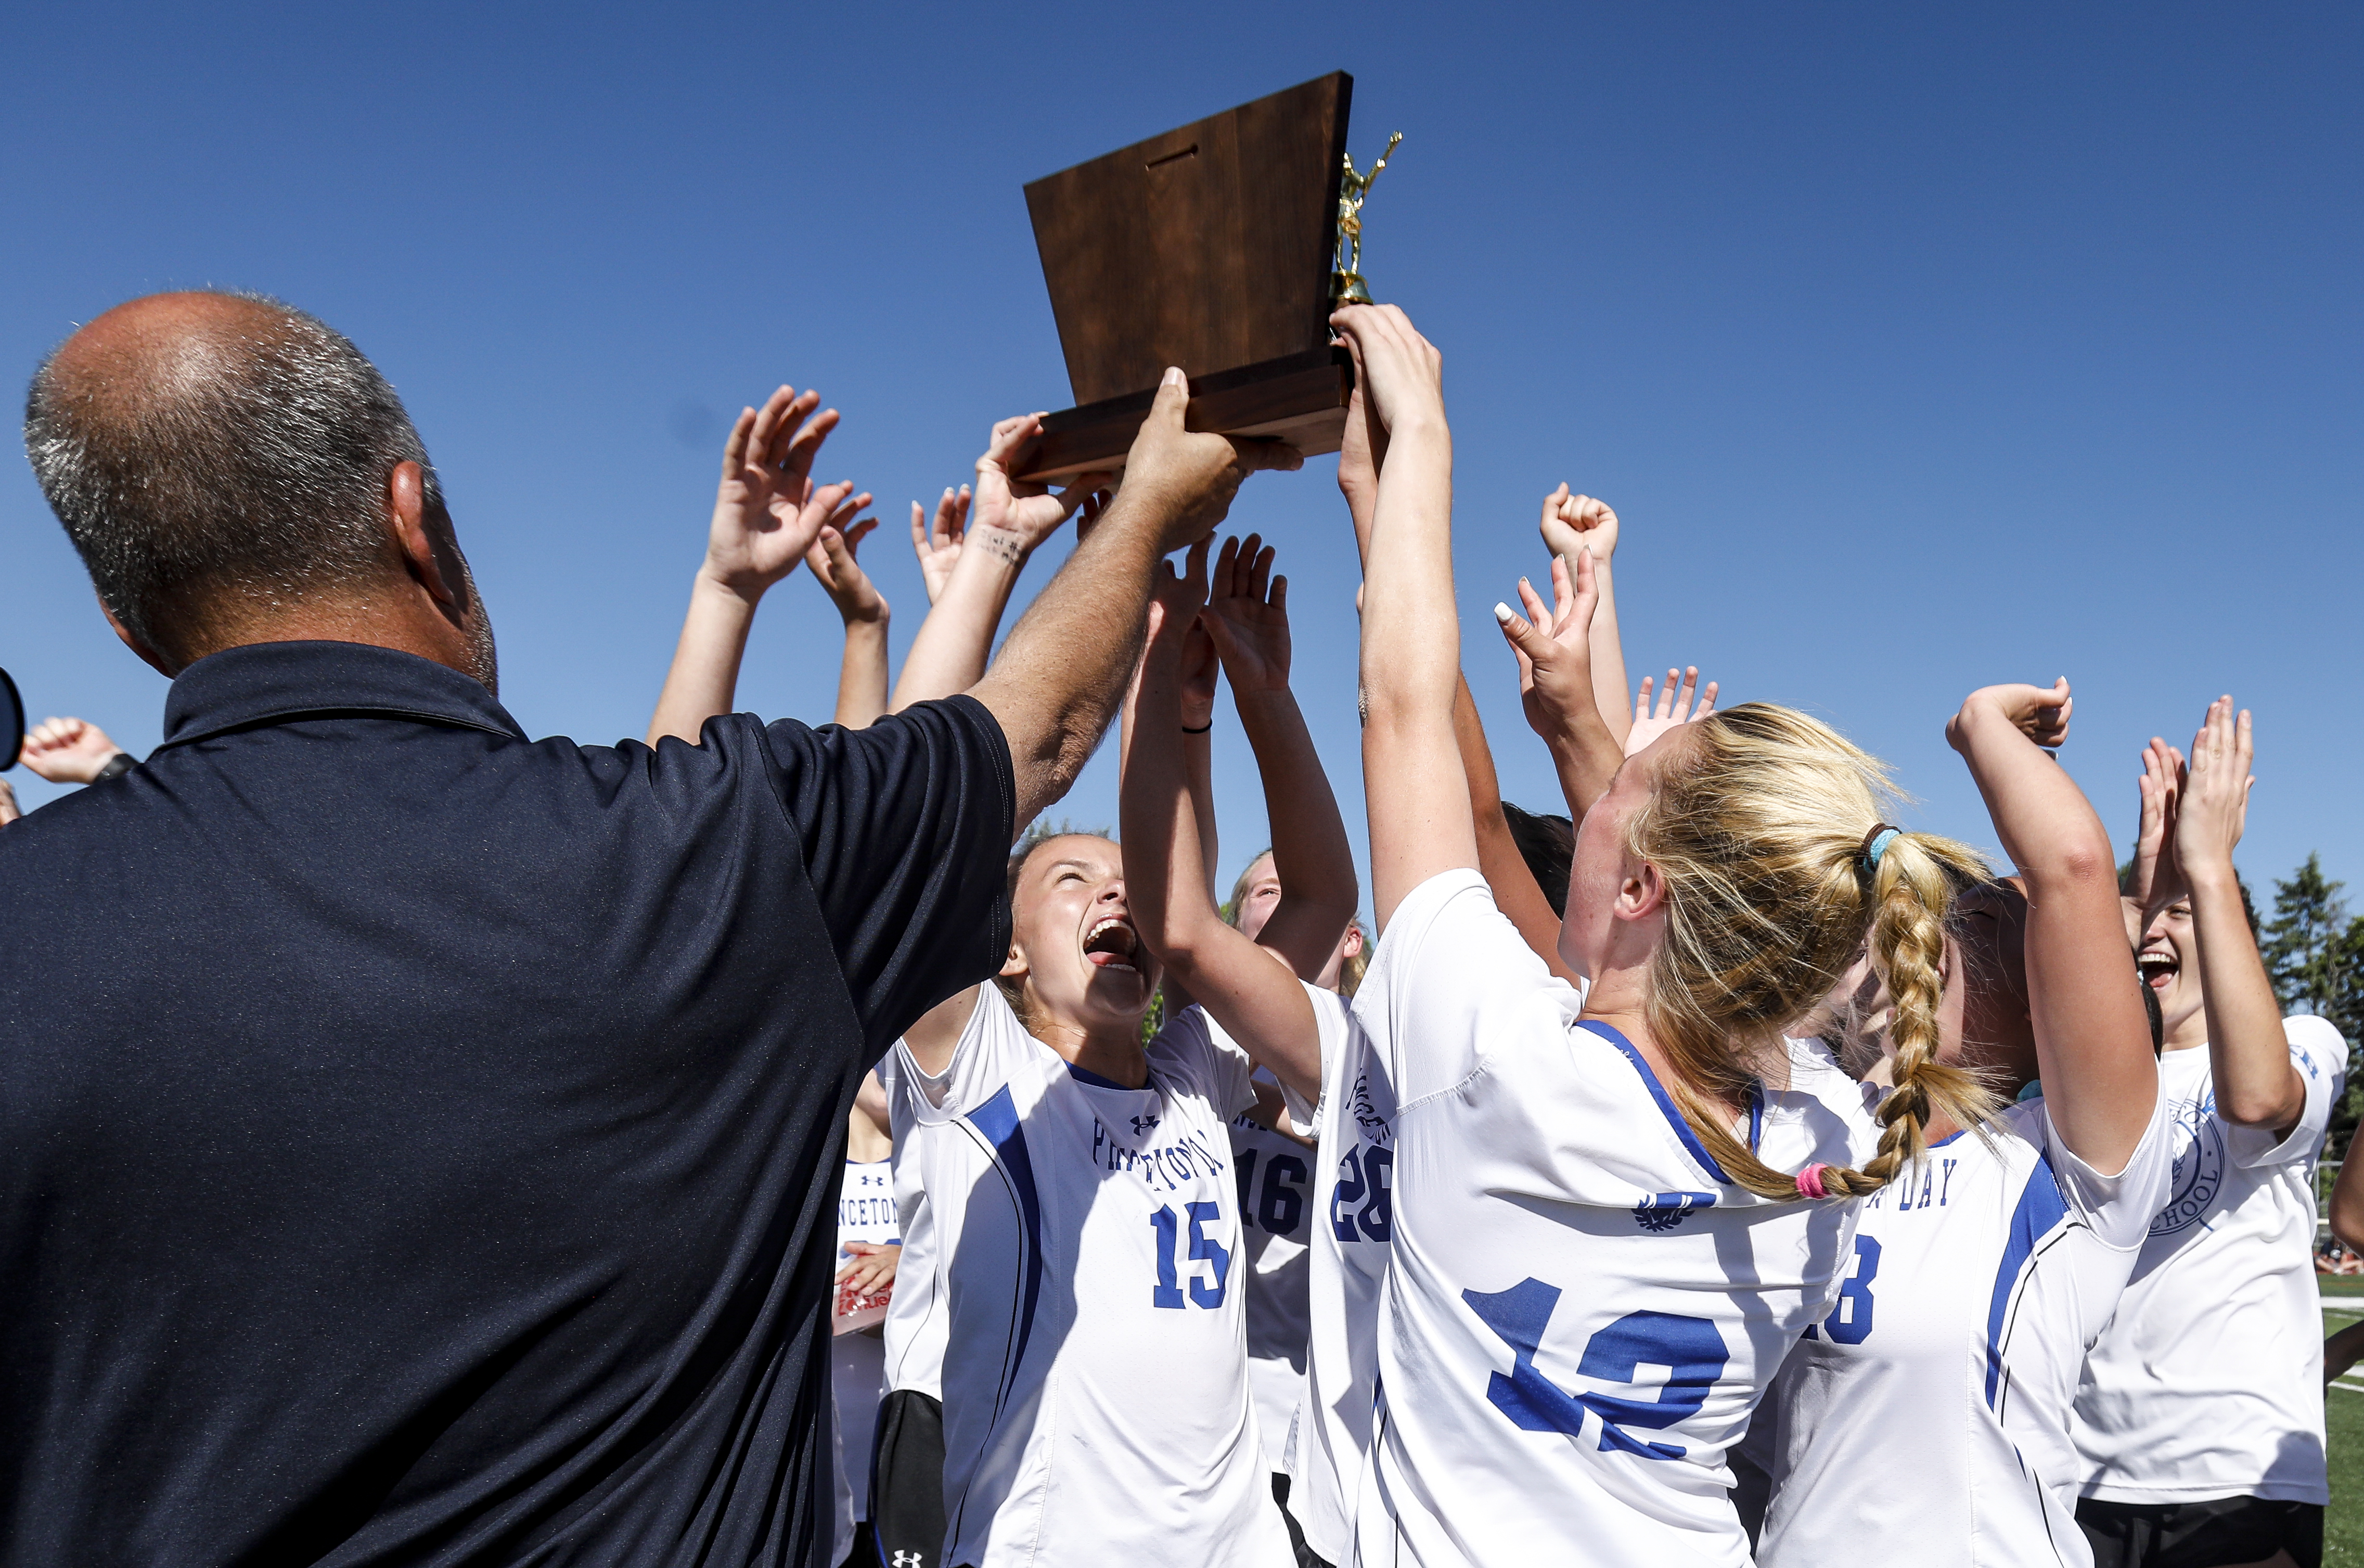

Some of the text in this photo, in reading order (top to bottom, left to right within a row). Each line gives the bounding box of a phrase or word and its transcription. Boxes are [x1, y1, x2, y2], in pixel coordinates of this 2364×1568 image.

[1234, 1147, 1308, 1236] 16
[1330, 1142, 1394, 1243] 28
[1150, 1201, 1229, 1309] 15
[1801, 1233, 1882, 1345] 8
[1462, 1277, 1730, 1460] 12
